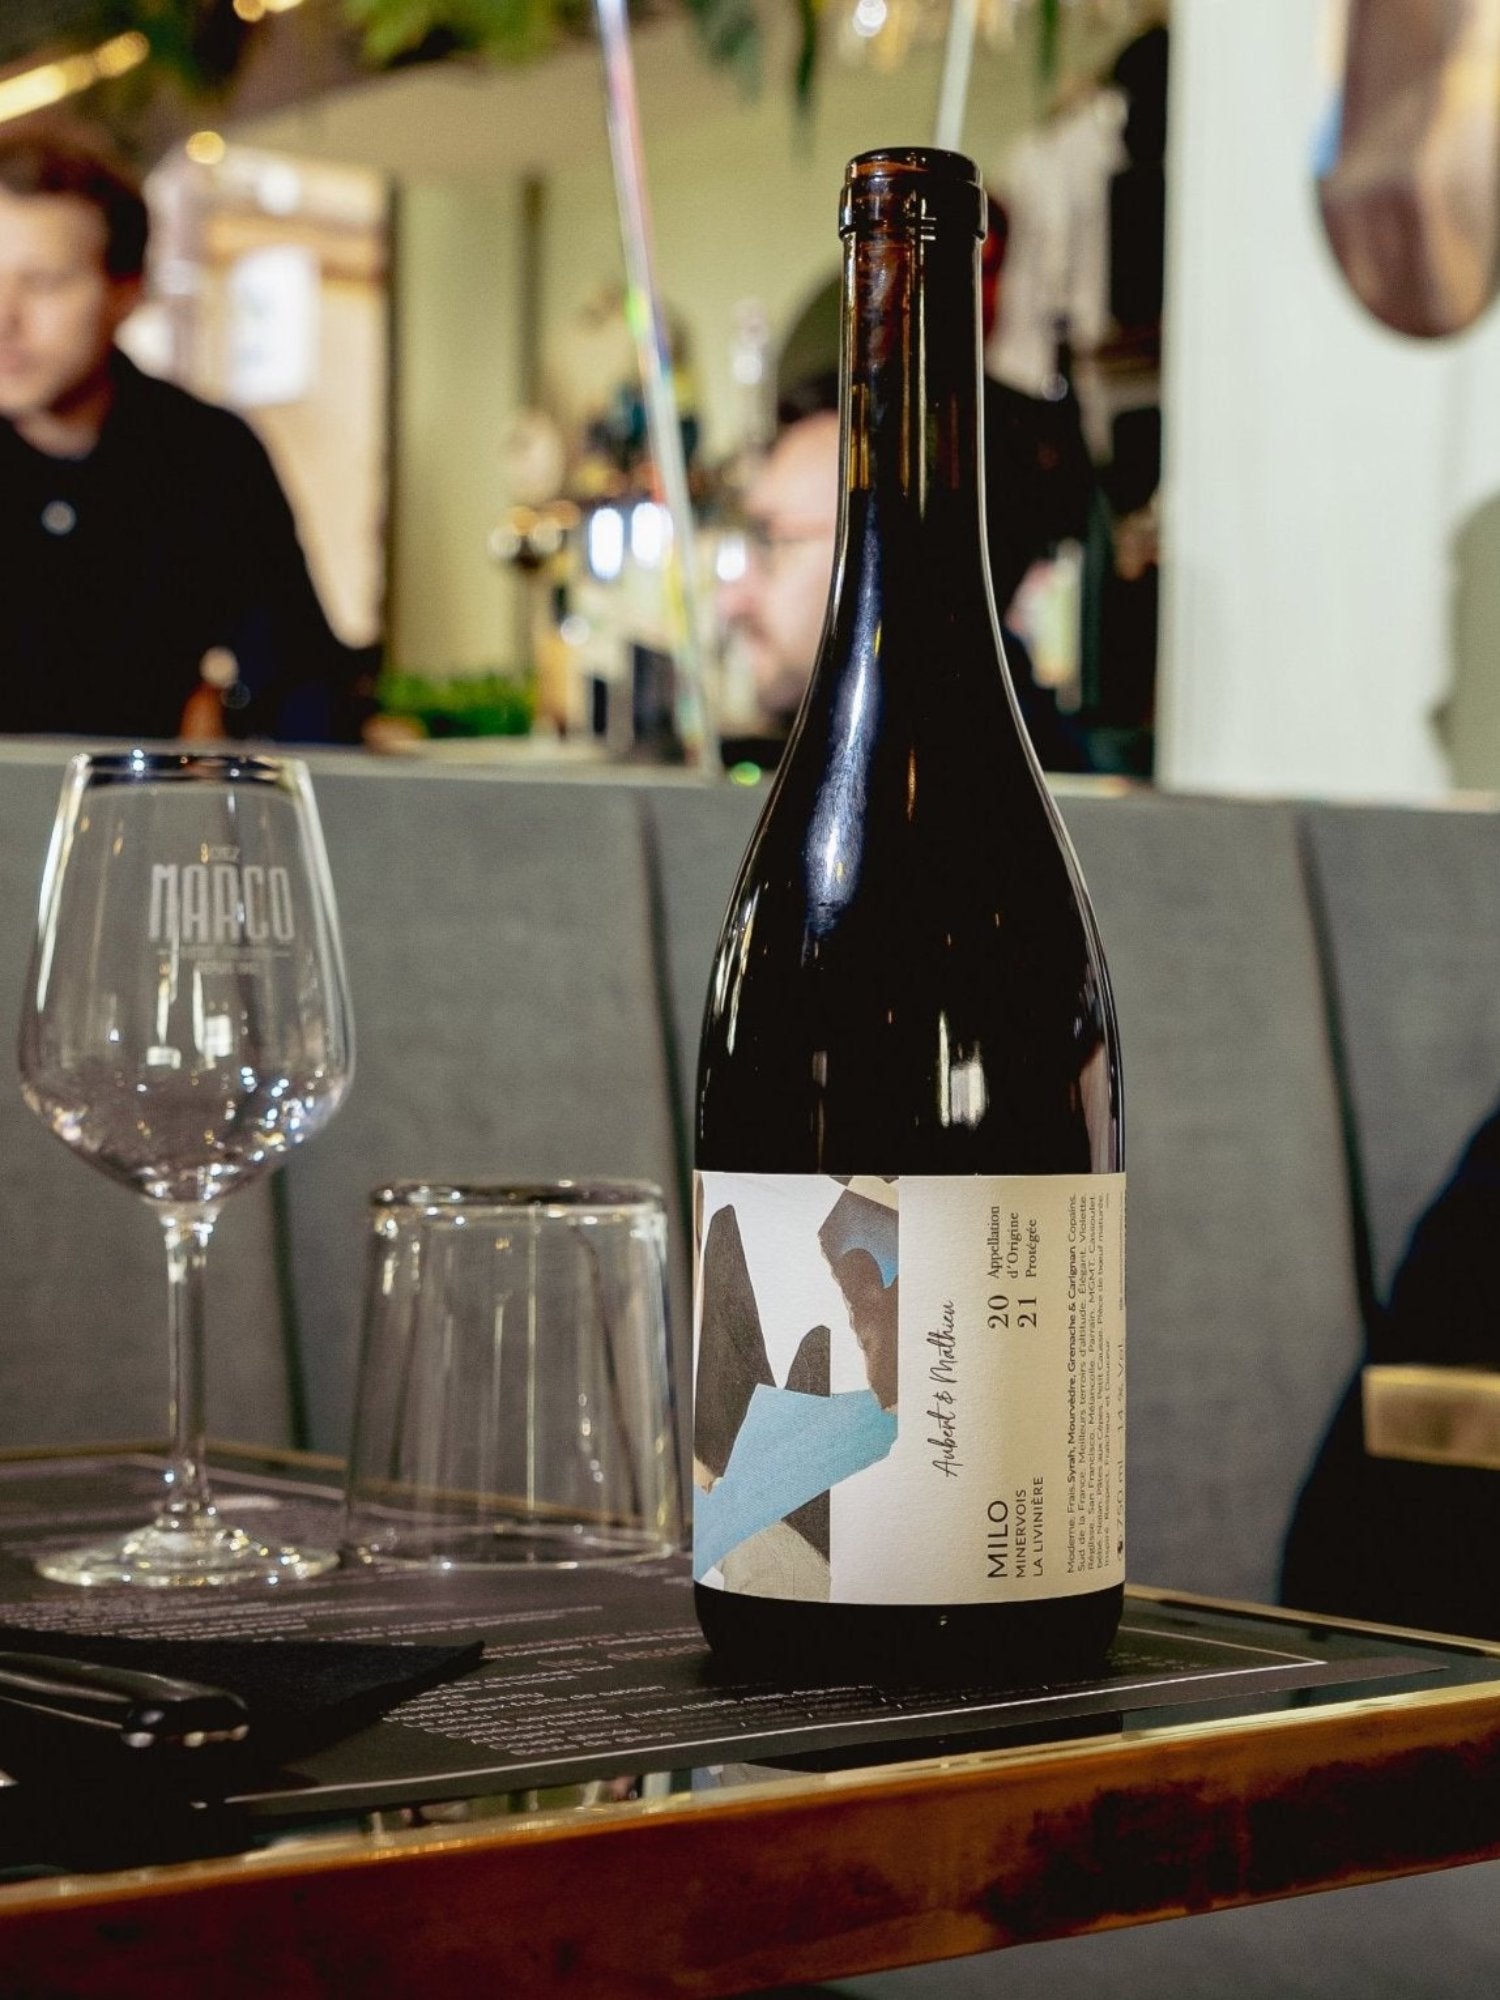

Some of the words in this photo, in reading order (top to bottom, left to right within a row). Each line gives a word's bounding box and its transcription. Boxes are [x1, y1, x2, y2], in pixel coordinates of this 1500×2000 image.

[149, 863, 295, 943] MARCO
[986, 1205, 1002, 1279] Appellation
[1006, 1212, 1022, 1279] d'Origine
[1025, 1219, 1040, 1278] Protégée
[1067, 1246, 1077, 1299] Carignan
[987, 1295, 1009, 1329] 20
[1017, 1295, 1037, 1328] 21
[1067, 1303, 1076, 1312] &
[925, 1300, 958, 1384] Mathieu
[1067, 1314, 1076, 1372] Grenache
[1078, 1361, 1086, 1404] terroirs
[926, 1402, 963, 1477] Aubert
[1078, 1410, 1086, 1463] Meilleurs
[1067, 1446, 1076, 1483] Syrah,
[987, 1501, 1008, 1578] MILO
[1015, 1489, 1027, 1578] MINERVOIS
[1031, 1476, 1044, 1552] LIVINIÈRE
[1078, 1516, 1086, 1526] la
[1078, 1530, 1086, 1545] de
[1033, 1557, 1044, 1577] LA
[1078, 1549, 1086, 1572] Sud
